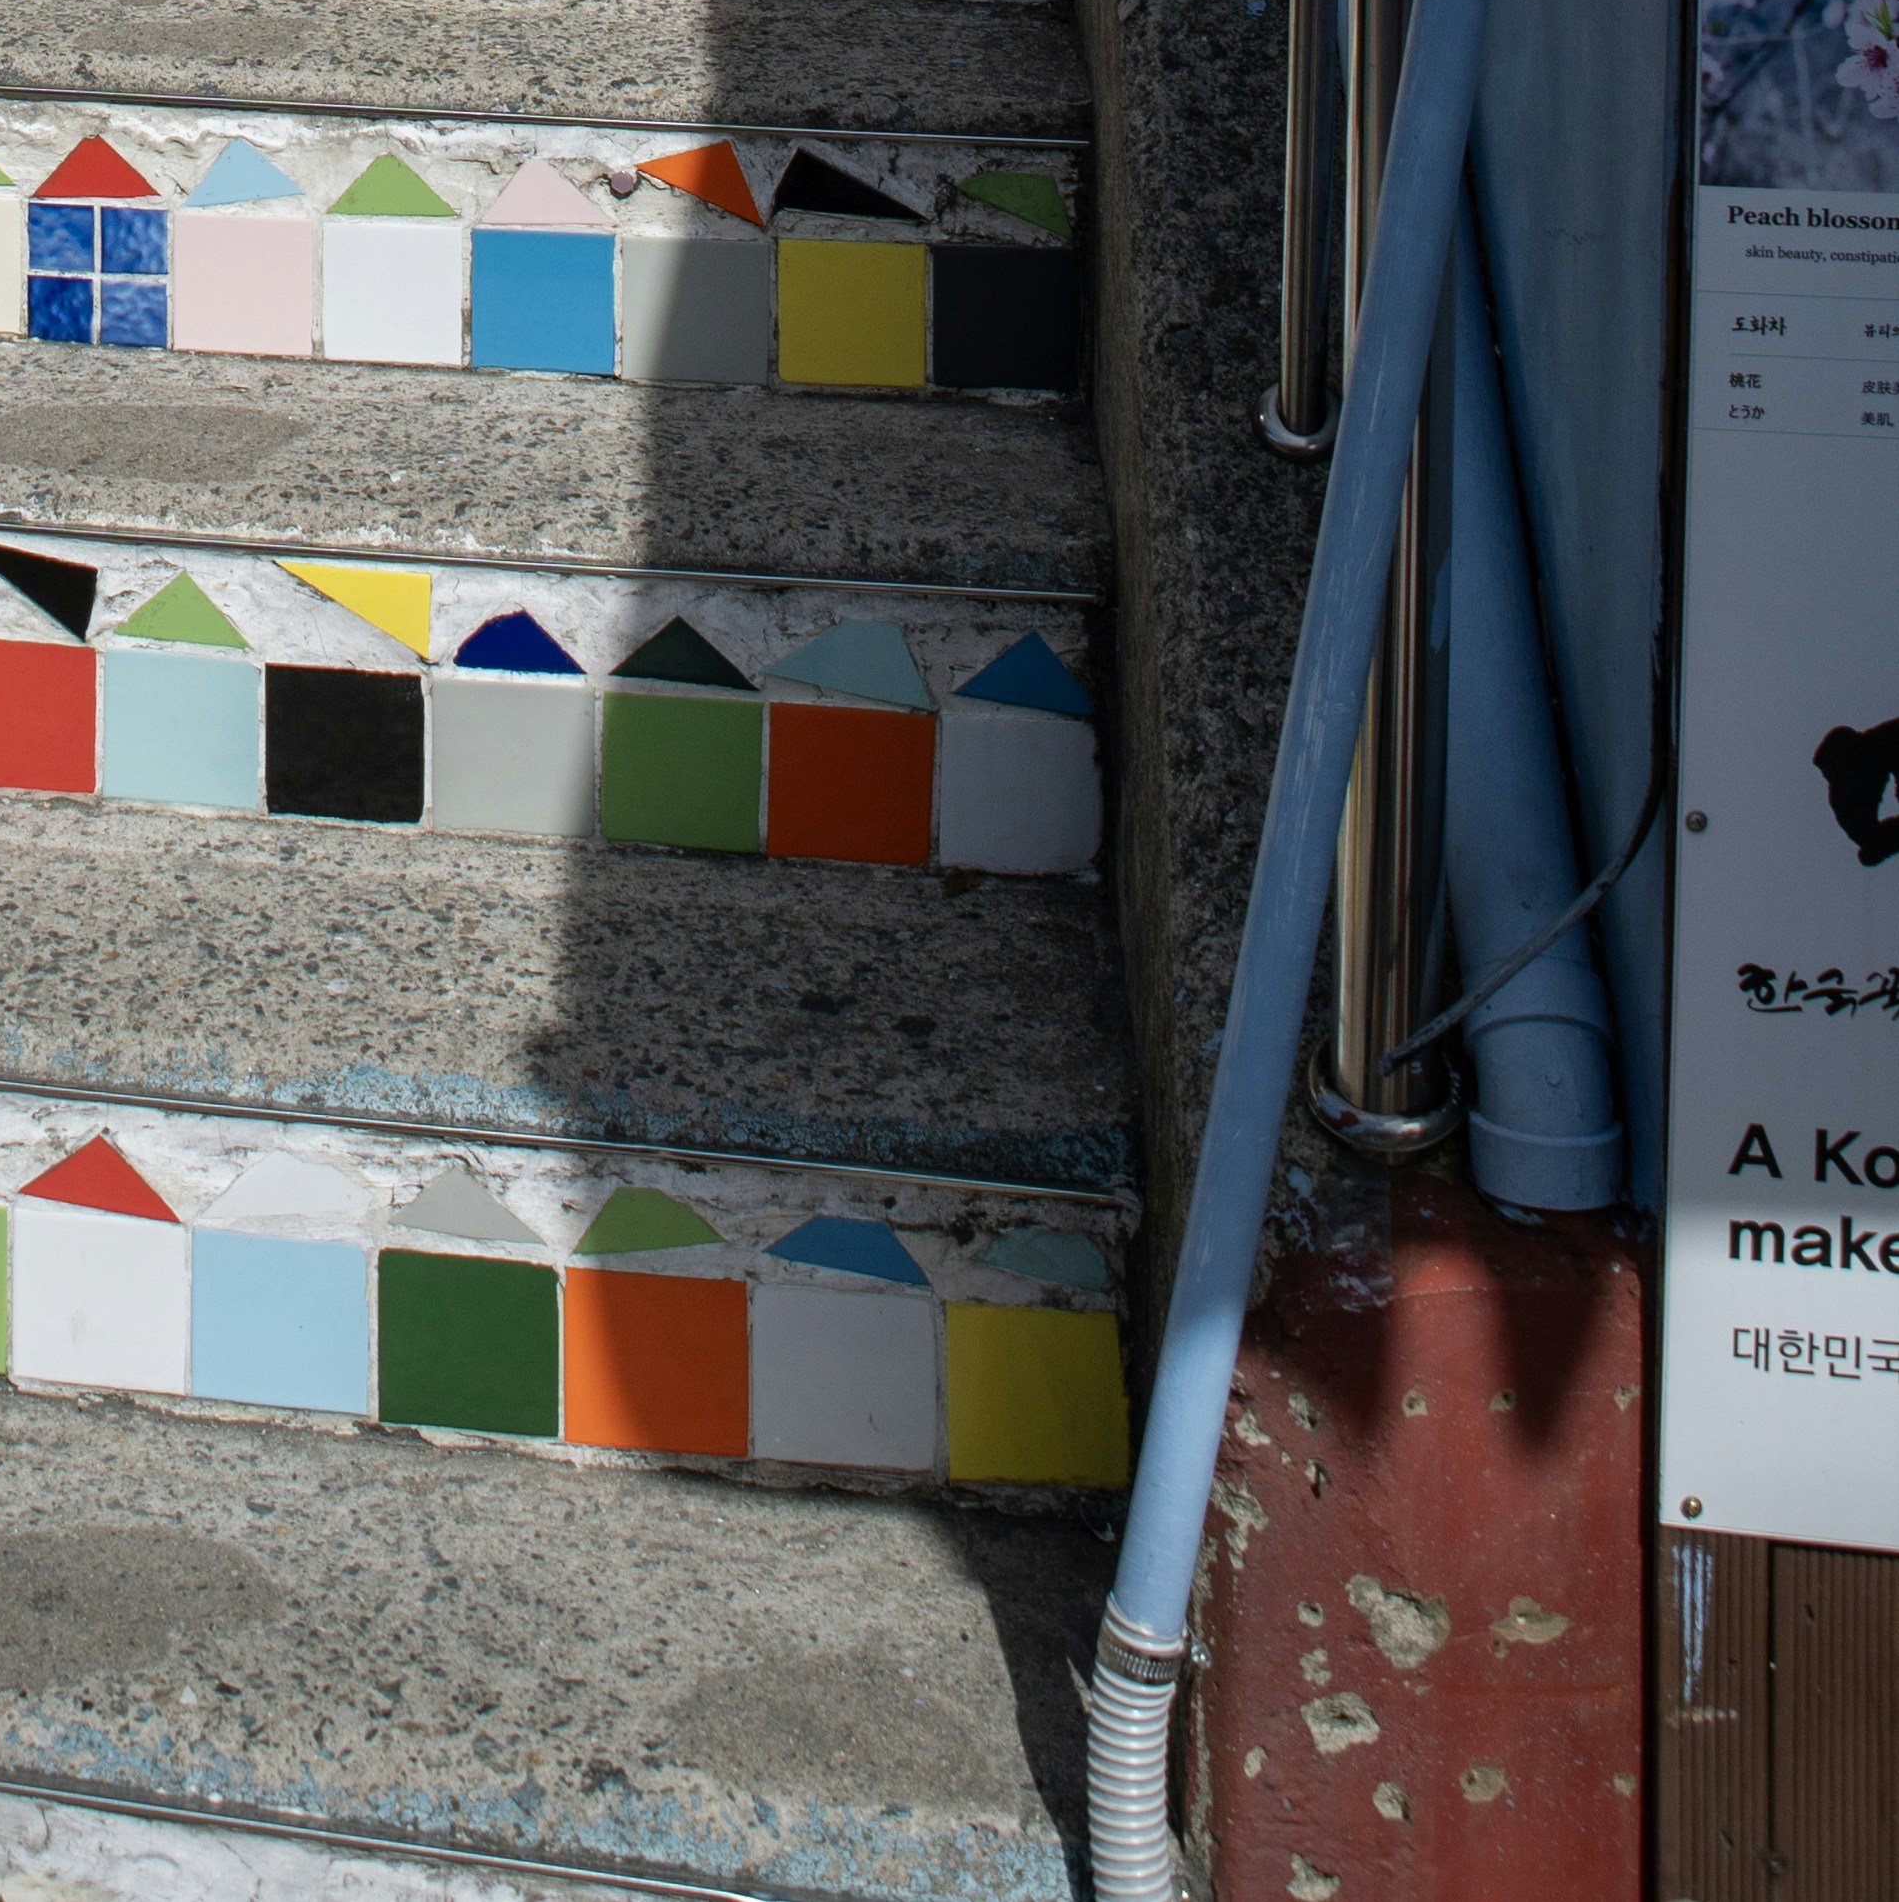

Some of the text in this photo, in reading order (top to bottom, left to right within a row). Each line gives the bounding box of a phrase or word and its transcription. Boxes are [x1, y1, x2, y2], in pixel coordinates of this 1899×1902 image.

[1727, 205, 1800, 226] Peach
[1746, 245, 1774, 258] skin
[1778, 246, 1827, 262] beauty,
[1731, 316, 1787, 335] 도화차
[1728, 372, 1762, 389] 桃花
[1728, 405, 1765, 419] とうか
[1727, 1123, 1899, 1189] A Ko
